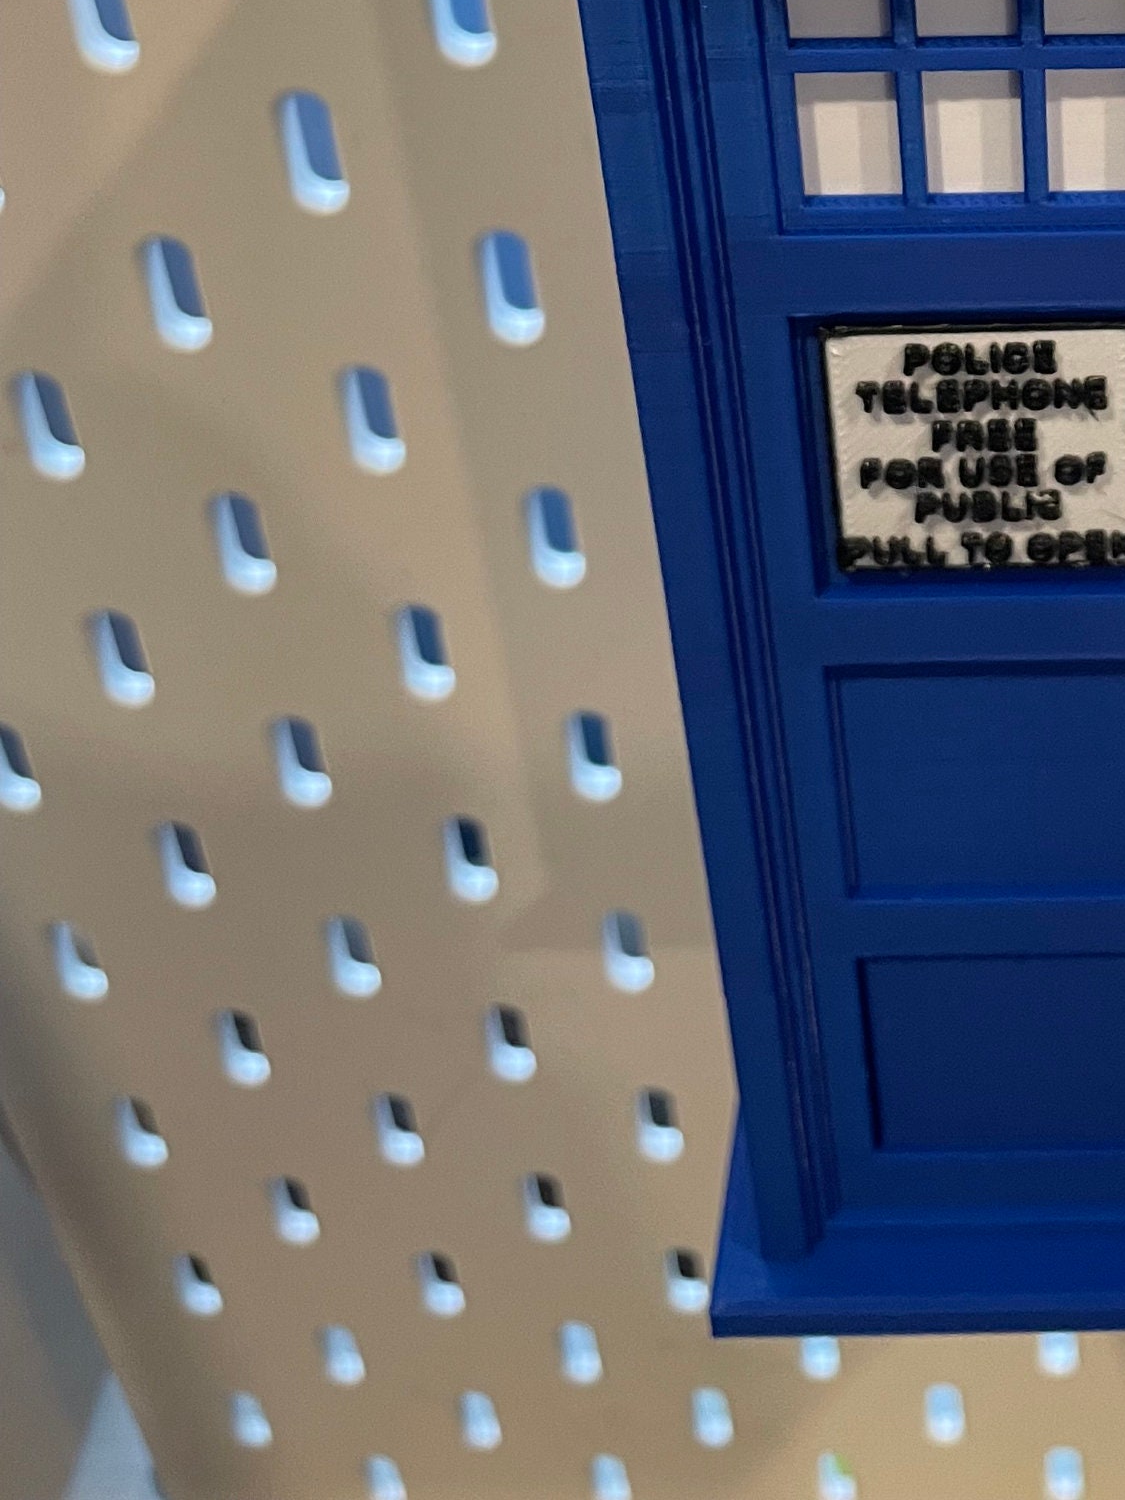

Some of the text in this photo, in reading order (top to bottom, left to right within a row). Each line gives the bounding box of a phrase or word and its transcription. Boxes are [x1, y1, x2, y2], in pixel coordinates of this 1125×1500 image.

[903, 340, 1057, 376] POLICE
[855, 375, 1107, 414] TELEPHONE
[932, 418, 1038, 453] FREE
[860, 451, 1107, 489] FOR USE OF
[914, 489, 1062, 523] PUBLIC
[837, 535, 947, 567] PULL
[961, 531, 1013, 564] TO
